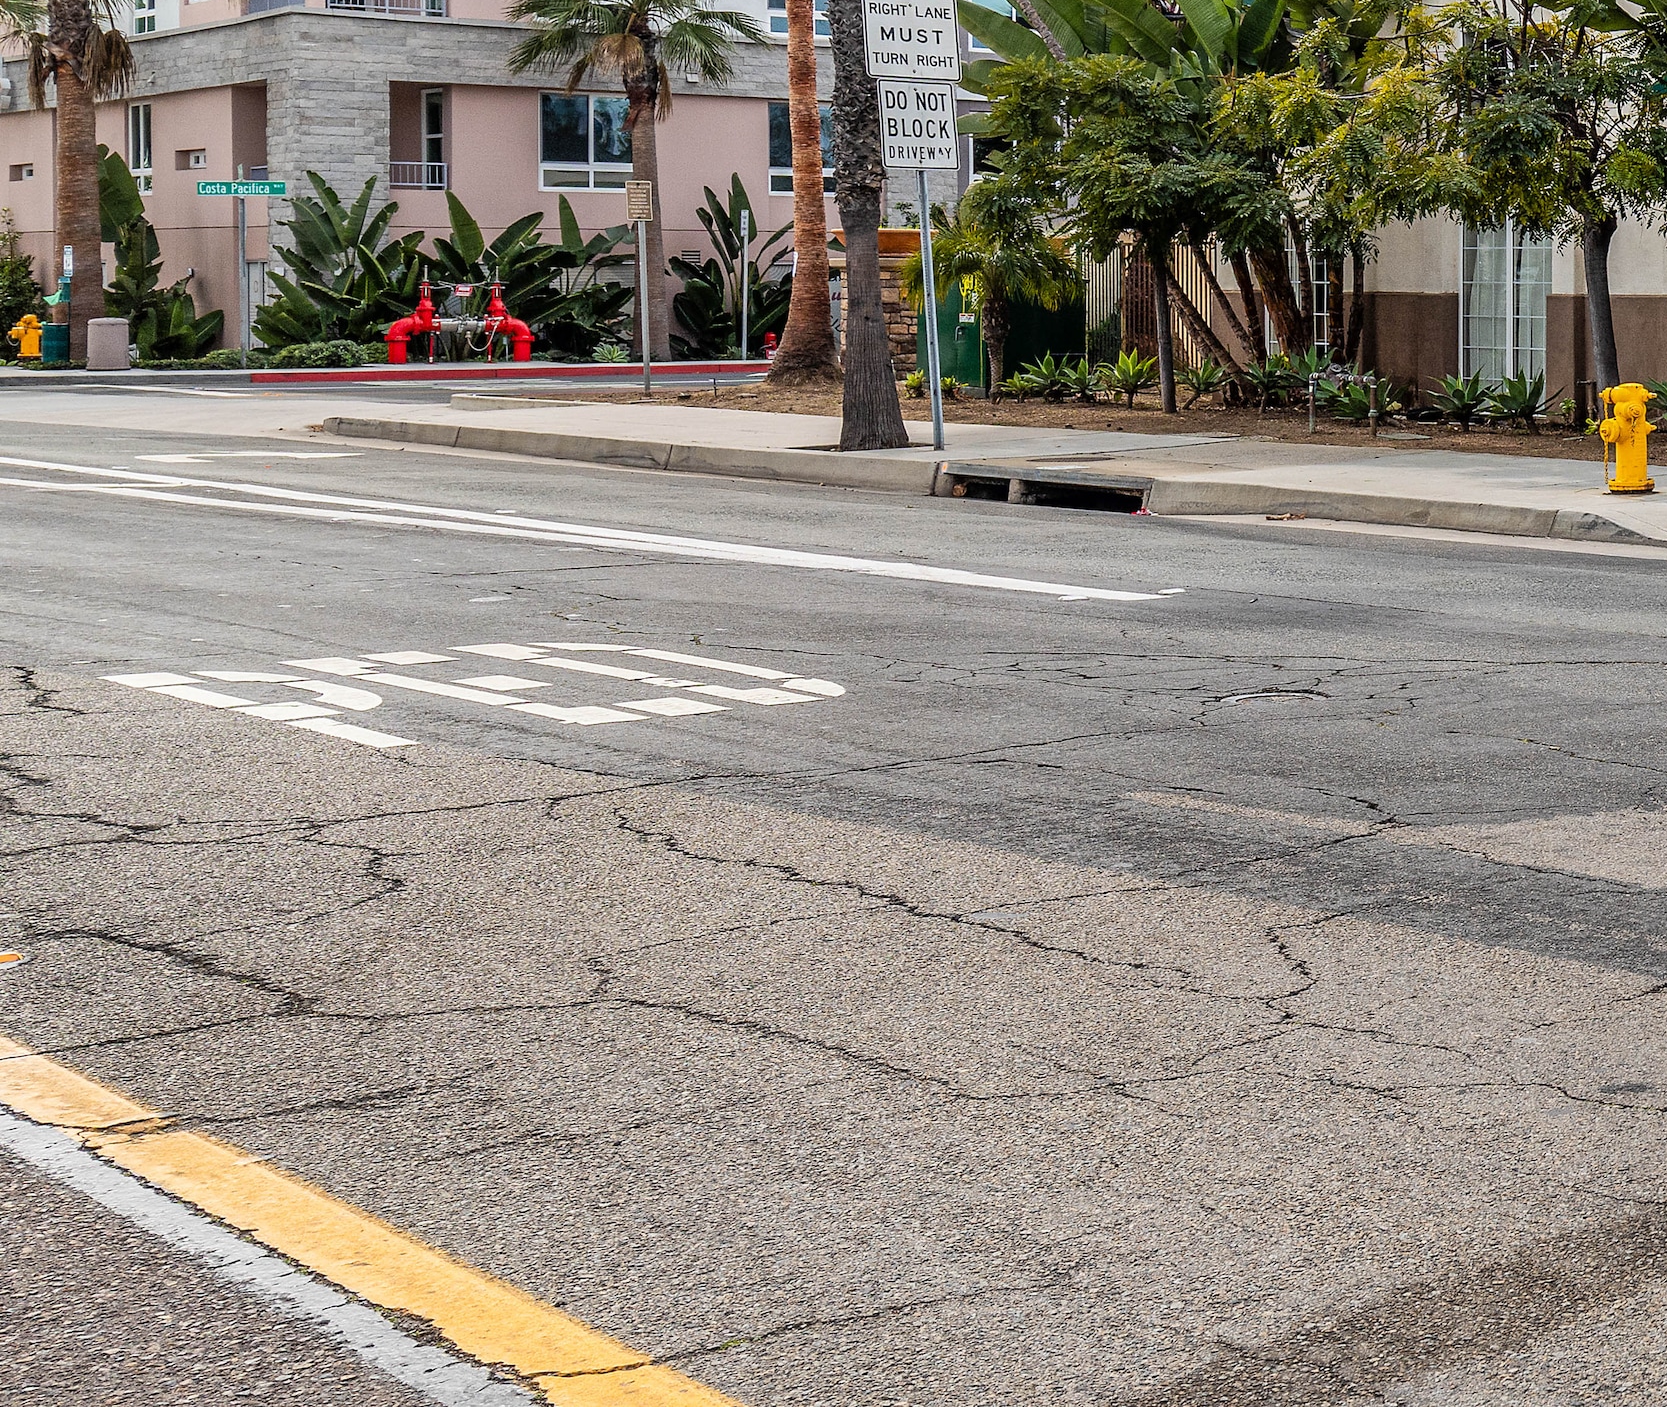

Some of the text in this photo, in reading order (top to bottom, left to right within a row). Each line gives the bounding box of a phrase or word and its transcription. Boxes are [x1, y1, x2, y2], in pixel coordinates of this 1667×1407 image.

[869, 2, 952, 20] RIGHT LANE
[880, 26, 943, 44] MUST
[872, 51, 954, 68] TURN RIGHT
[885, 90, 947, 112] DO NOT
[887, 117, 950, 139] BLOCK
[889, 145, 952, 160] DRIVEWAY
[199, 182, 226, 194] Costa
[231, 182, 270, 194] Pacifica
